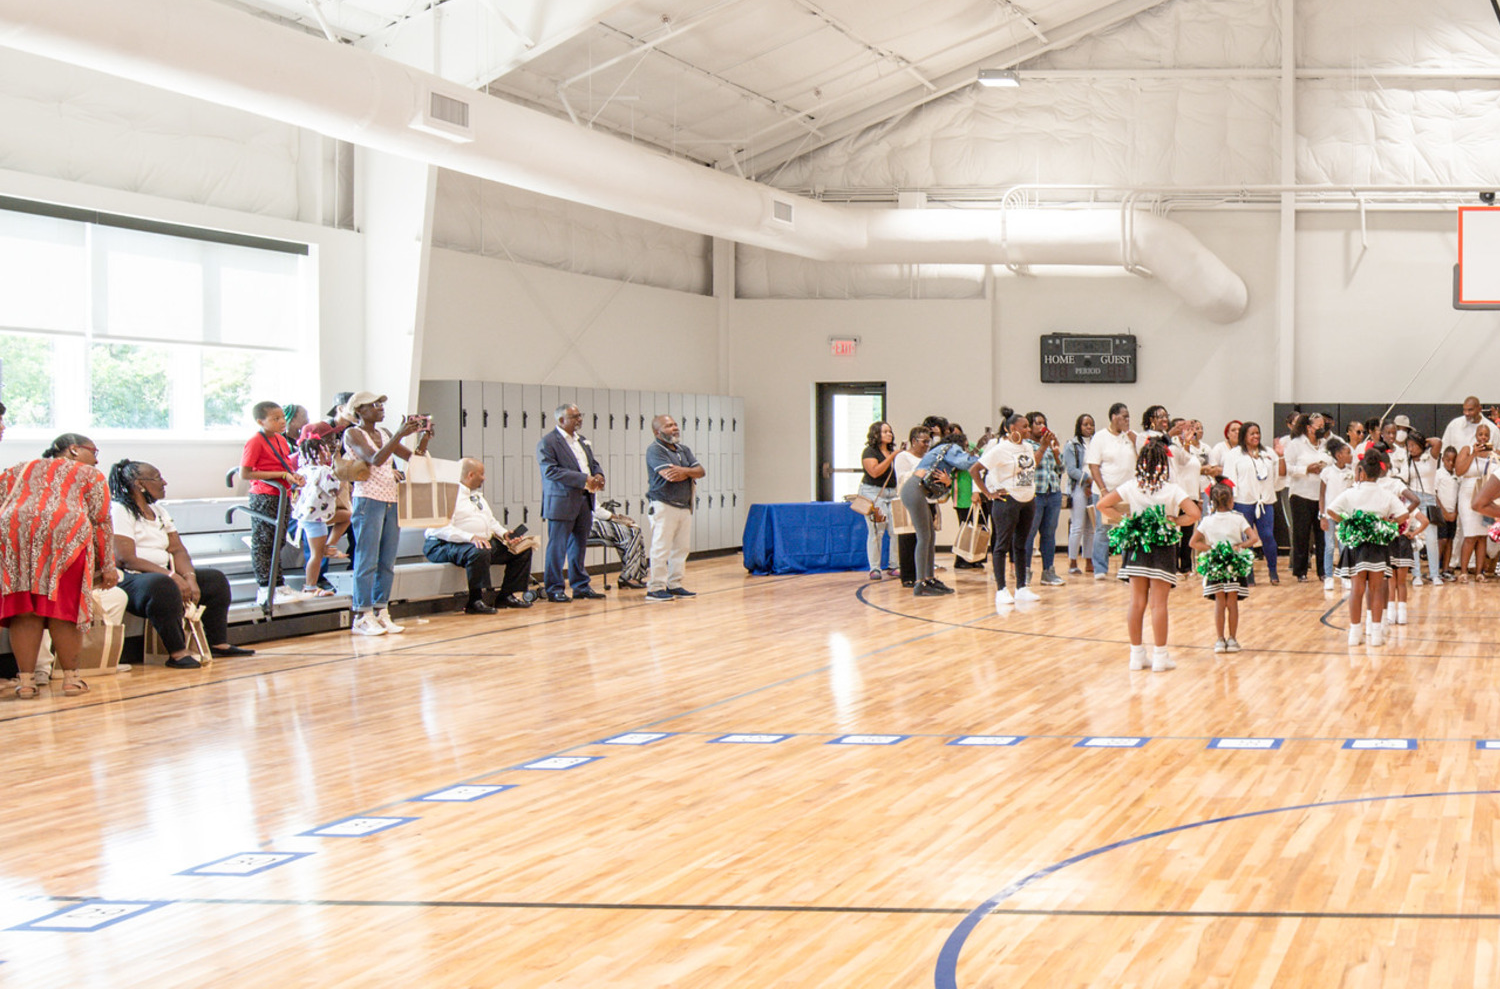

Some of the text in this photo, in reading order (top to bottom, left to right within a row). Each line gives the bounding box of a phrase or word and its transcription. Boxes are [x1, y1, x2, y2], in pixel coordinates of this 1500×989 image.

[835, 341, 852, 355] EXIT
[1044, 355, 1075, 364] HOME
[1100, 355, 1132, 364] GUEST
[1075, 367, 1101, 375] PERIOD
